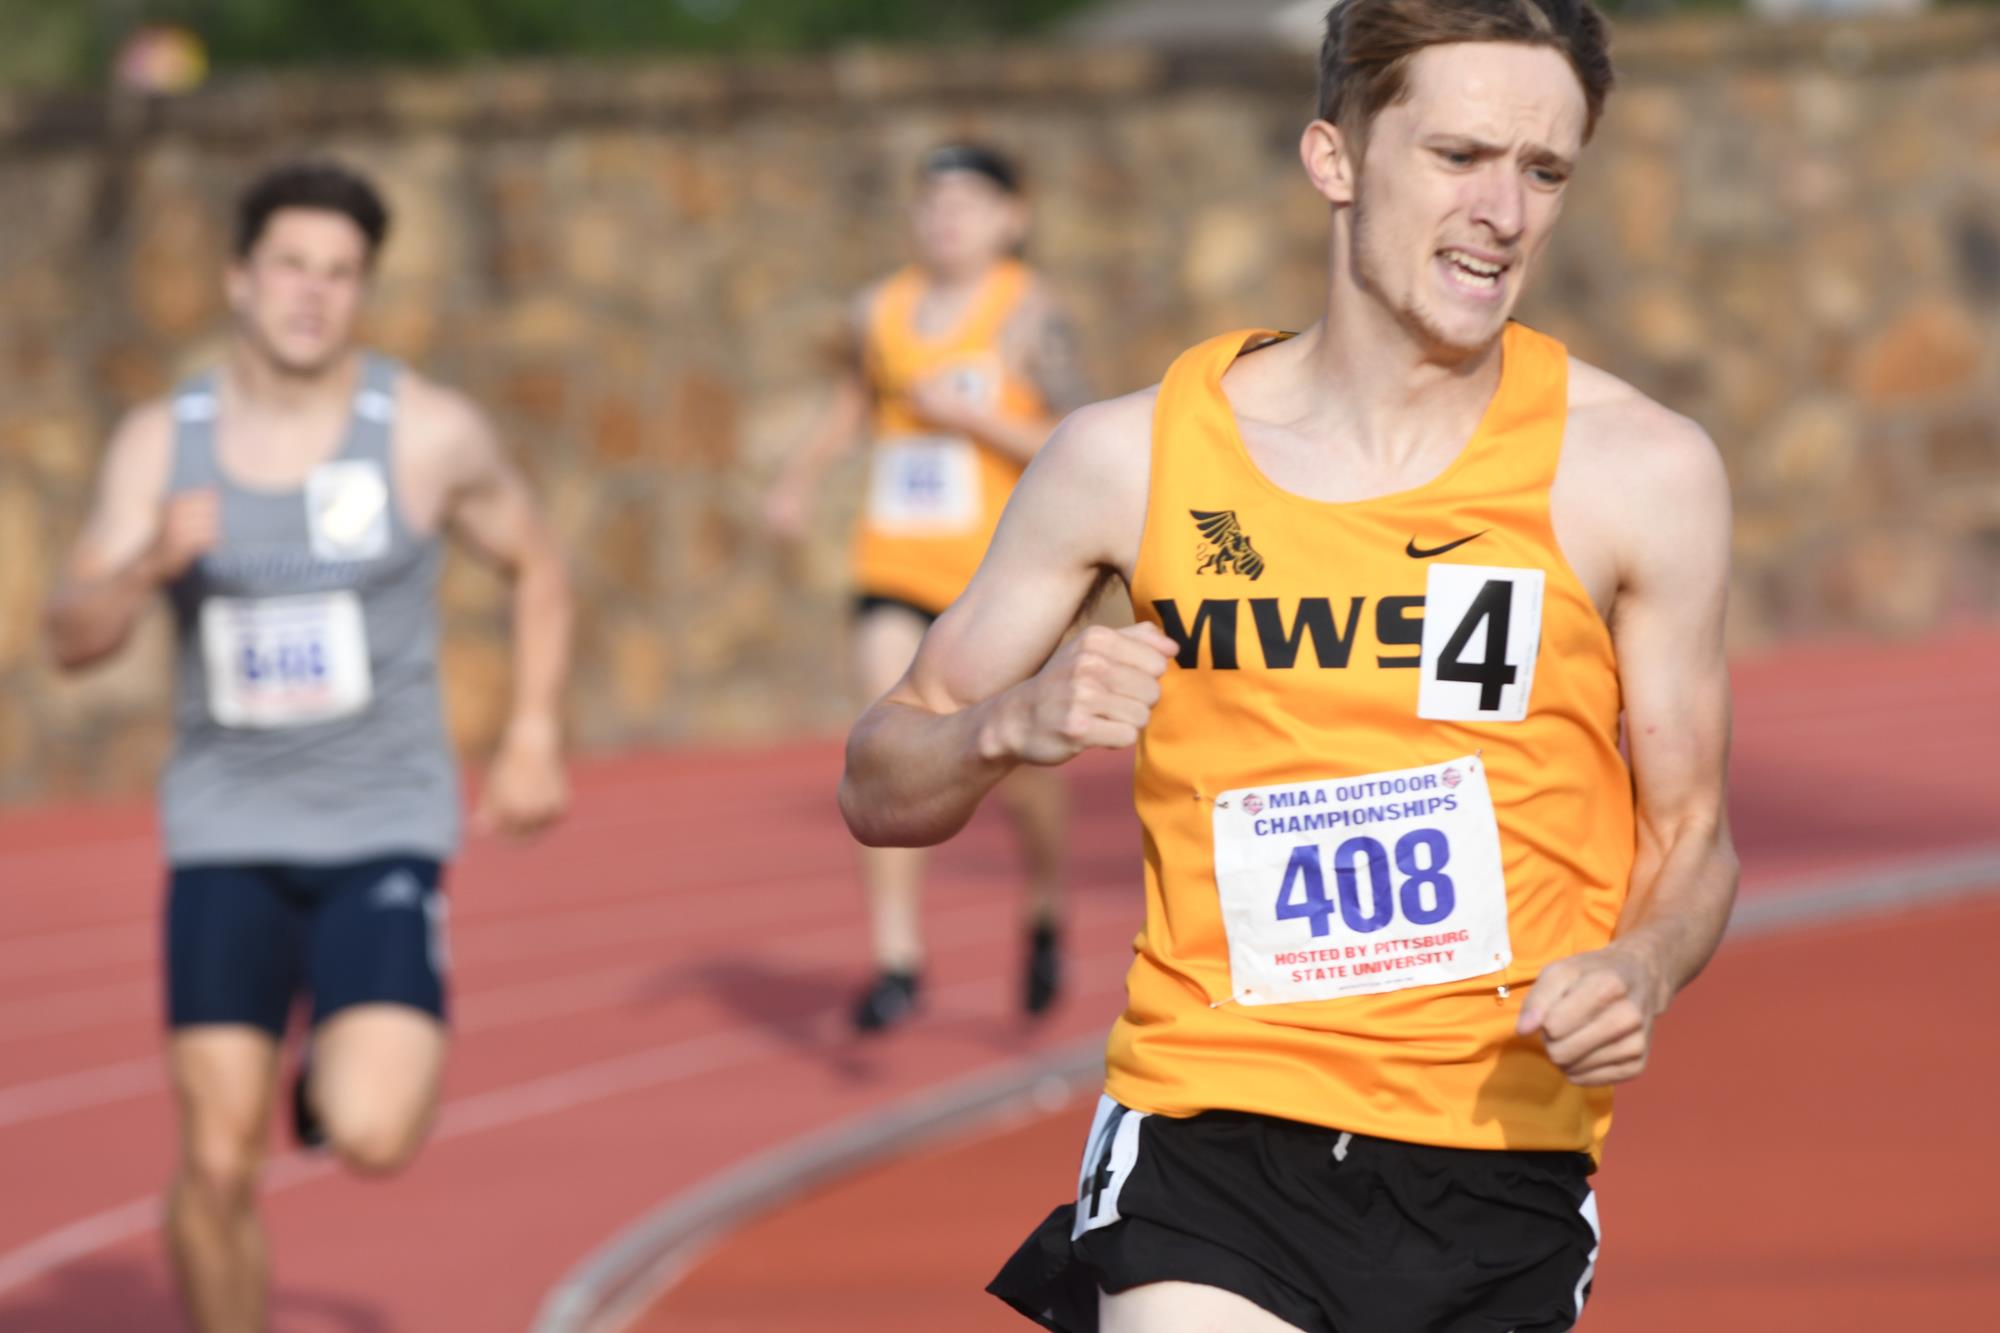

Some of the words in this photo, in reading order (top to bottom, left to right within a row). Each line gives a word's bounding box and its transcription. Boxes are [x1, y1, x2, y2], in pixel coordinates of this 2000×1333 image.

[1151, 596, 1426, 670] MWS
[1436, 579, 1517, 711] 4
[1254, 794, 1458, 836] CHAMPIONSHIPS
[1268, 789, 1328, 809] MIAA
[1335, 774, 1438, 802] OUTDOOR
[1275, 828, 1456, 937] 408
[1275, 948, 1341, 966] HOSTED
[1345, 945, 1368, 959] BY
[1375, 929, 1470, 955] PITTSBURG
[1292, 965, 1347, 983] STATE
[1353, 950, 1454, 976] UNIVERSITY
[1081, 1103, 1129, 1219] 4
